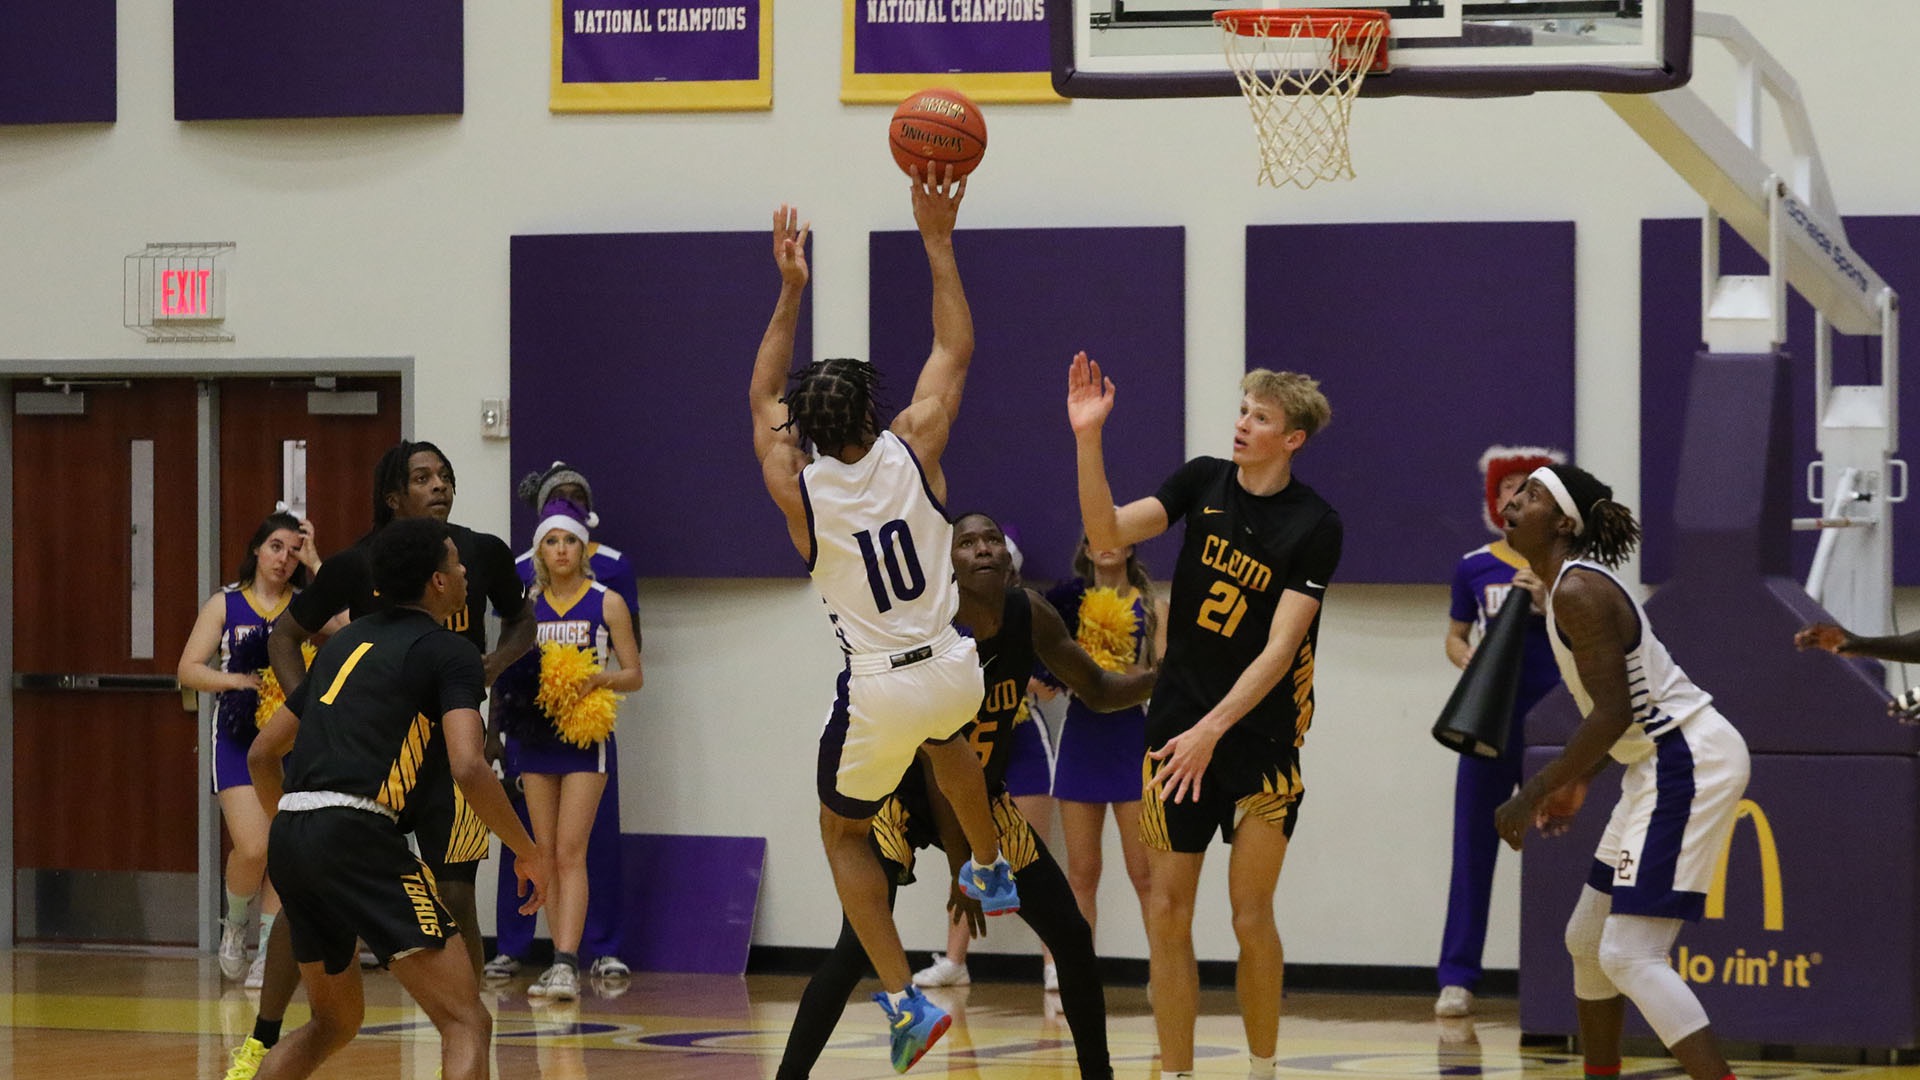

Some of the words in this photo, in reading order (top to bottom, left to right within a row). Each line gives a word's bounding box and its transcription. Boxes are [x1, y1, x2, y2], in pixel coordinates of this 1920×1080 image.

[574, 8, 652, 33] NATIONAL
[657, 6, 746, 32] CHAMPIONS
[867, 0, 946, 24] NATIONAL
[951, 0, 1045, 23] CHAMPIONS
[162, 269, 210, 315] EXIT
[852, 518, 926, 614] 10
[1201, 534, 1273, 592] CLOUD
[1196, 580, 1248, 638] 21
[319, 642, 374, 705] 1
